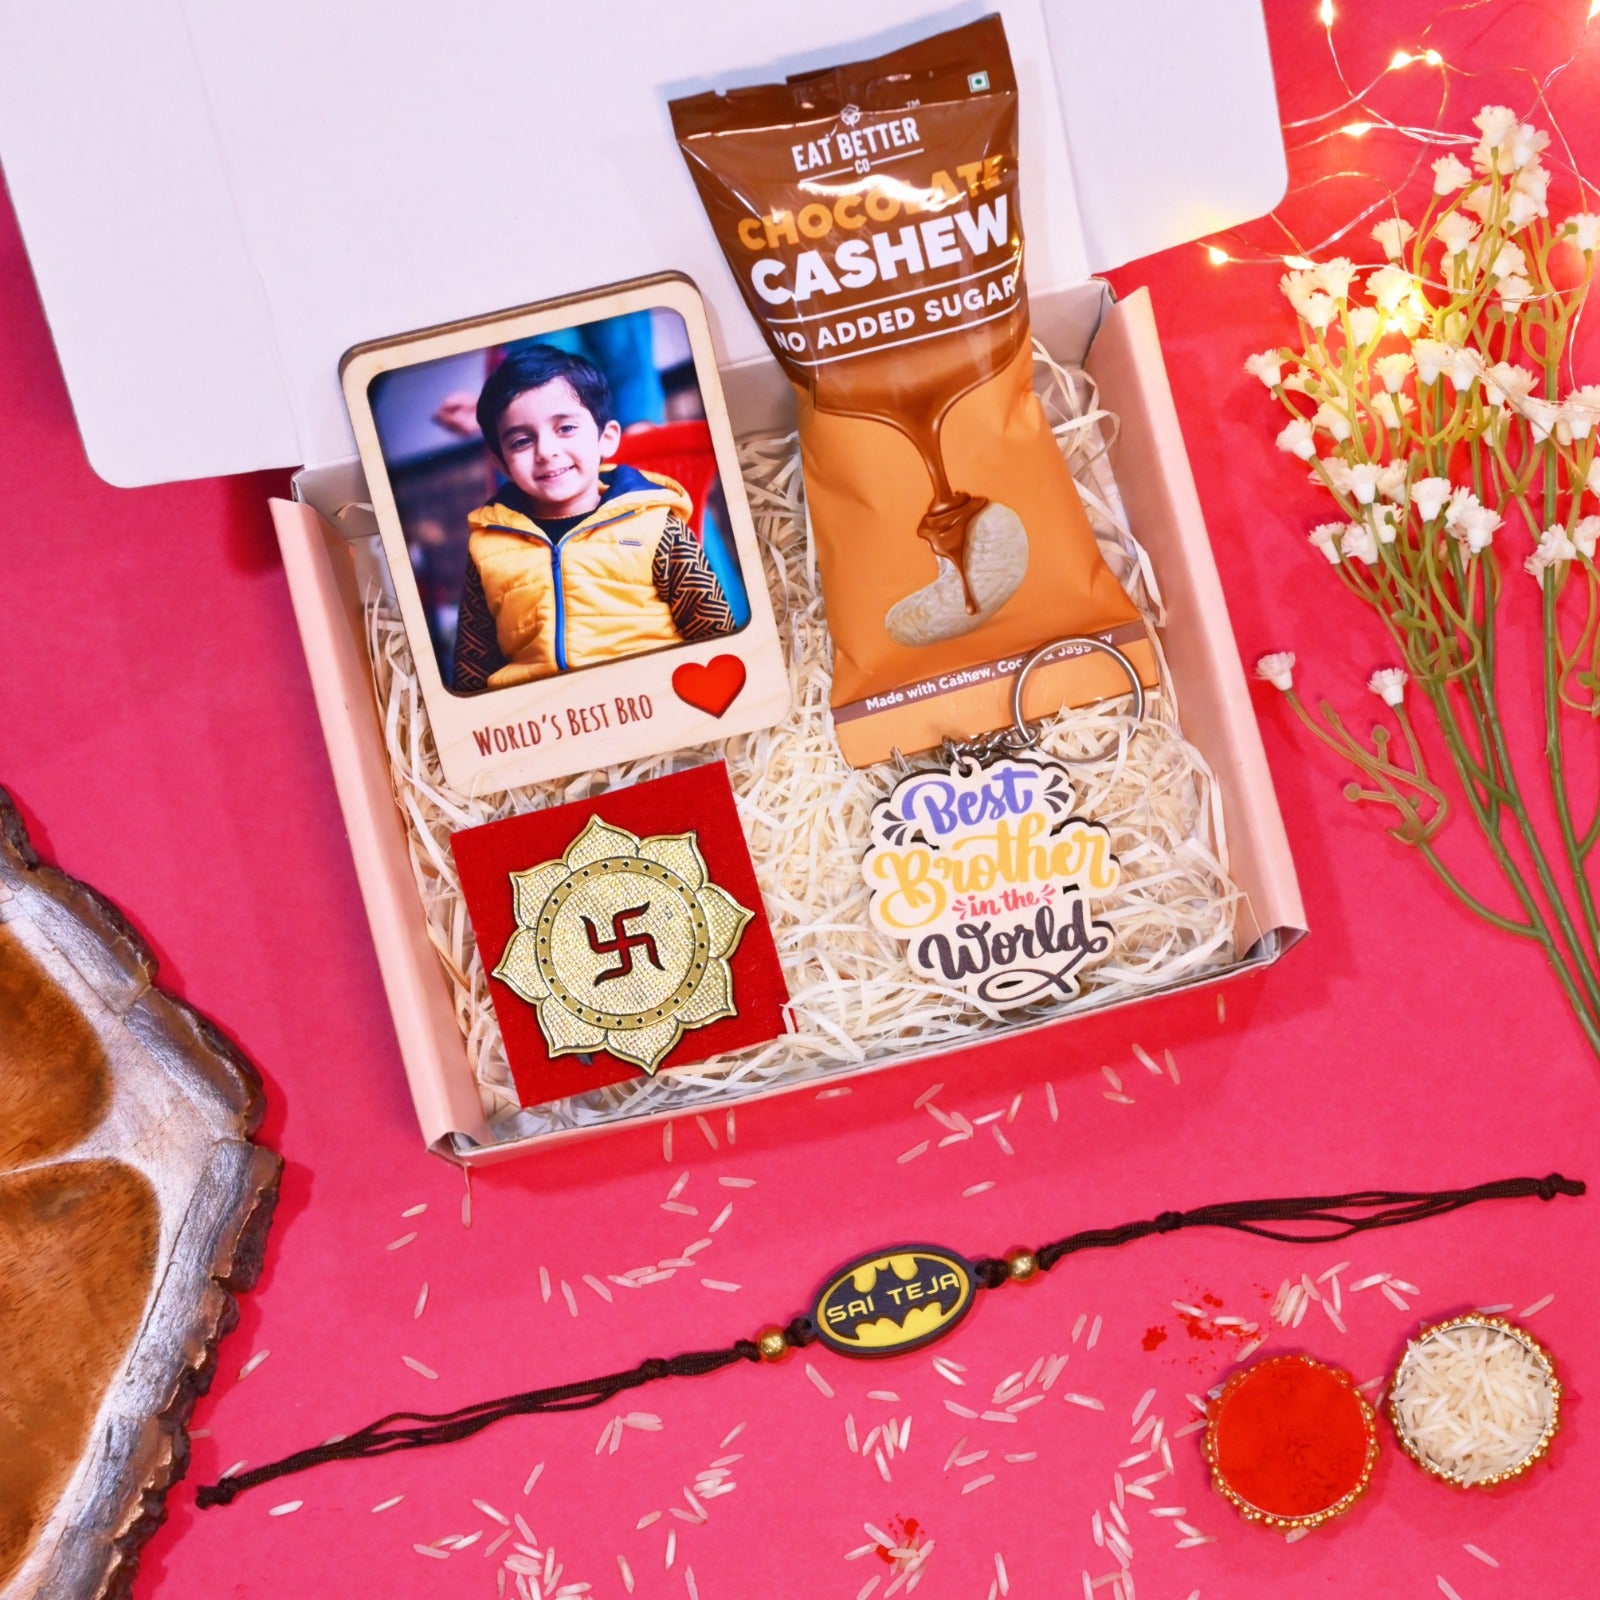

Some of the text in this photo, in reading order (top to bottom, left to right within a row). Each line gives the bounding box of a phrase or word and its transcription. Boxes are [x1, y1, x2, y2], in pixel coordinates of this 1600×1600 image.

[791, 117, 921, 172] EAT BETTER
[854, 158, 871, 174] CO
[750, 194, 1009, 305] CASHEW
[773, 274, 1016, 353] NO ADDED SUGAR
[865, 691, 905, 711] Made
[906, 681, 937, 700] with
[938, 664, 995, 689] Cashew,
[997, 655, 1034, 674] Coc
[472, 694, 654, 757] WORLD'S BEST BRO
[901, 767, 1039, 835] Best
[872, 812, 1116, 929] Brother
[970, 888, 1041, 917] in the
[917, 899, 1109, 981] World
[826, 1272, 960, 1324] SAI TEJA
